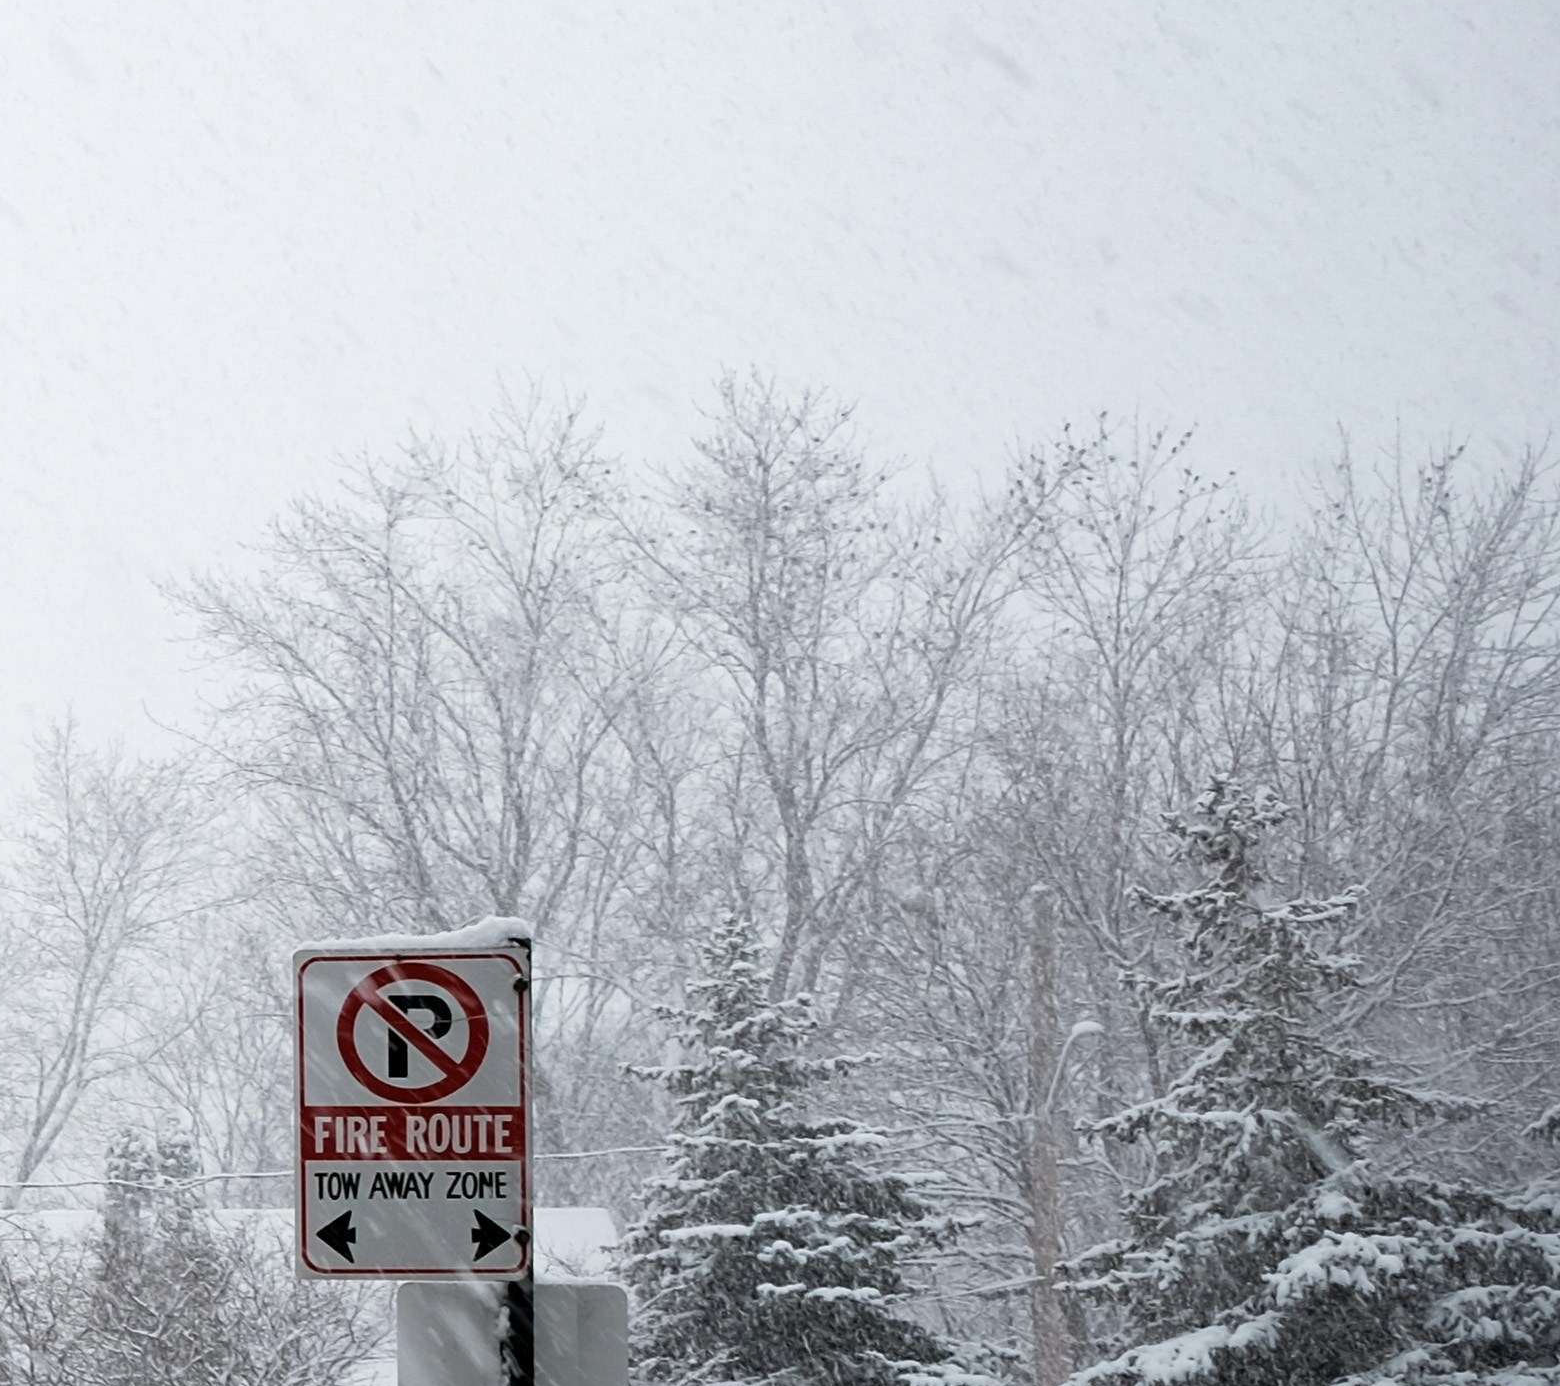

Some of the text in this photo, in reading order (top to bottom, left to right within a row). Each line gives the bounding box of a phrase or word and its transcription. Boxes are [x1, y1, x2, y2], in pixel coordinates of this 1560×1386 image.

[314, 1113, 512, 1154] FIRE ROUTE
[314, 1171, 507, 1200] TOW AWAY ZONE
